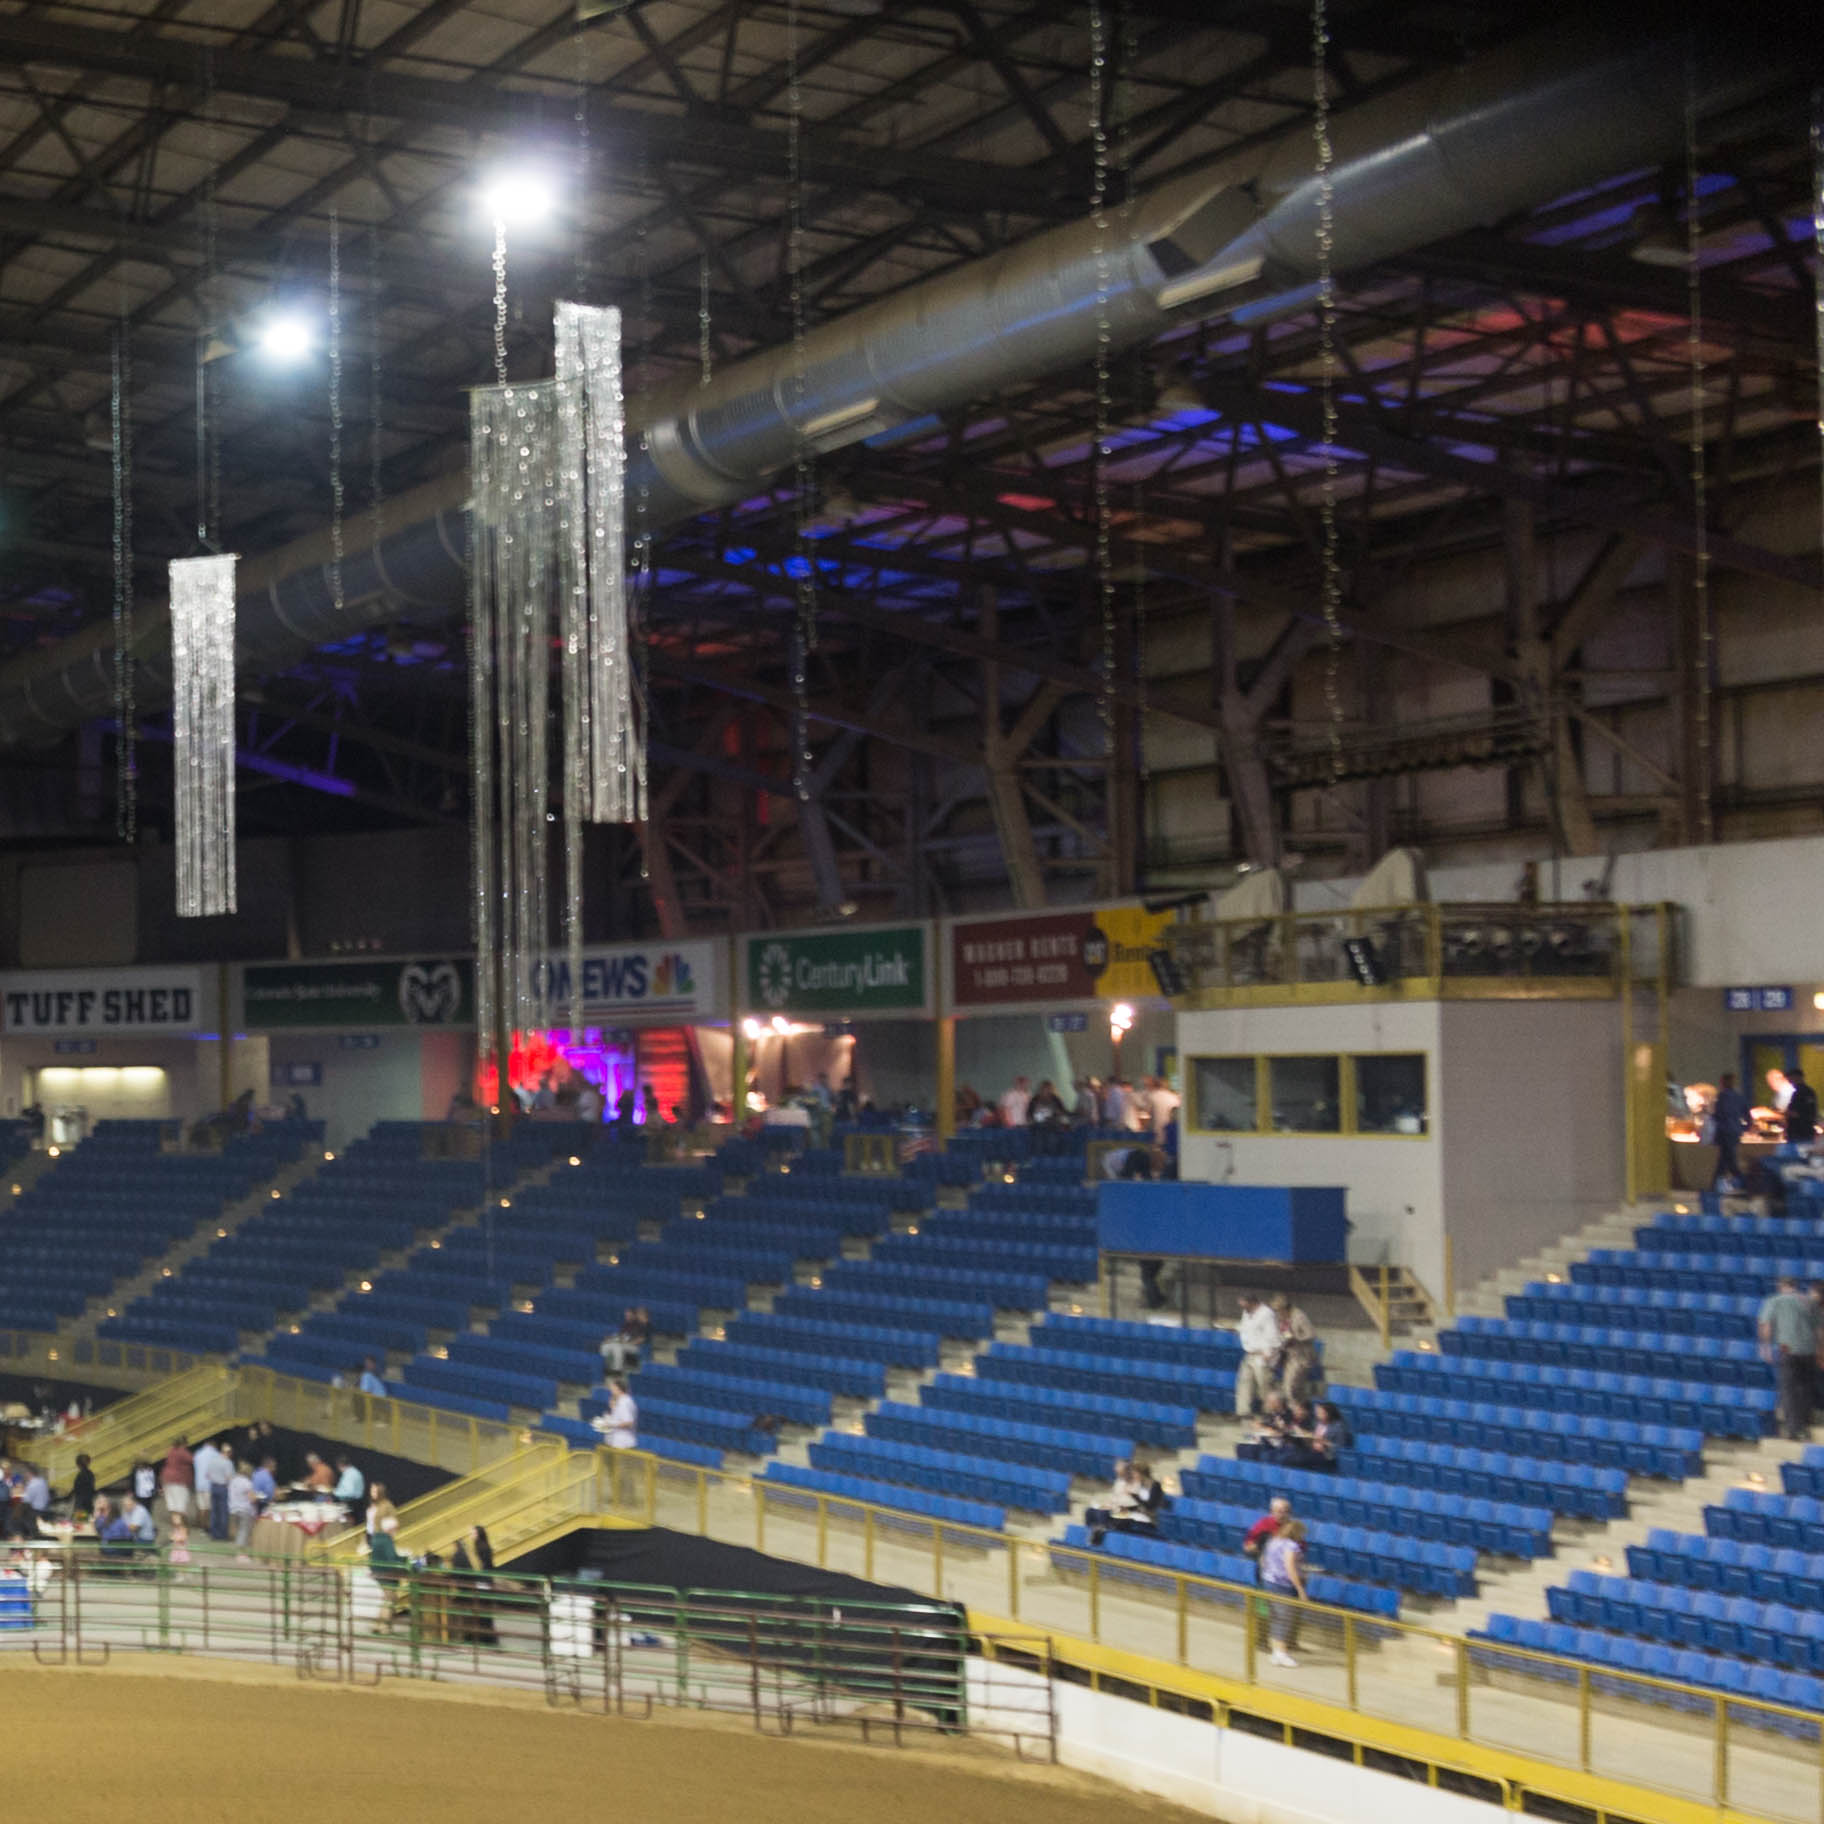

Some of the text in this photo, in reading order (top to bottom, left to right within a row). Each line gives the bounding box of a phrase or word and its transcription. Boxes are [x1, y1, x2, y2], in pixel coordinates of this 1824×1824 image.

[794, 949, 910, 993] CenturyLink
[6, 987, 193, 1027] TUFF SHED
